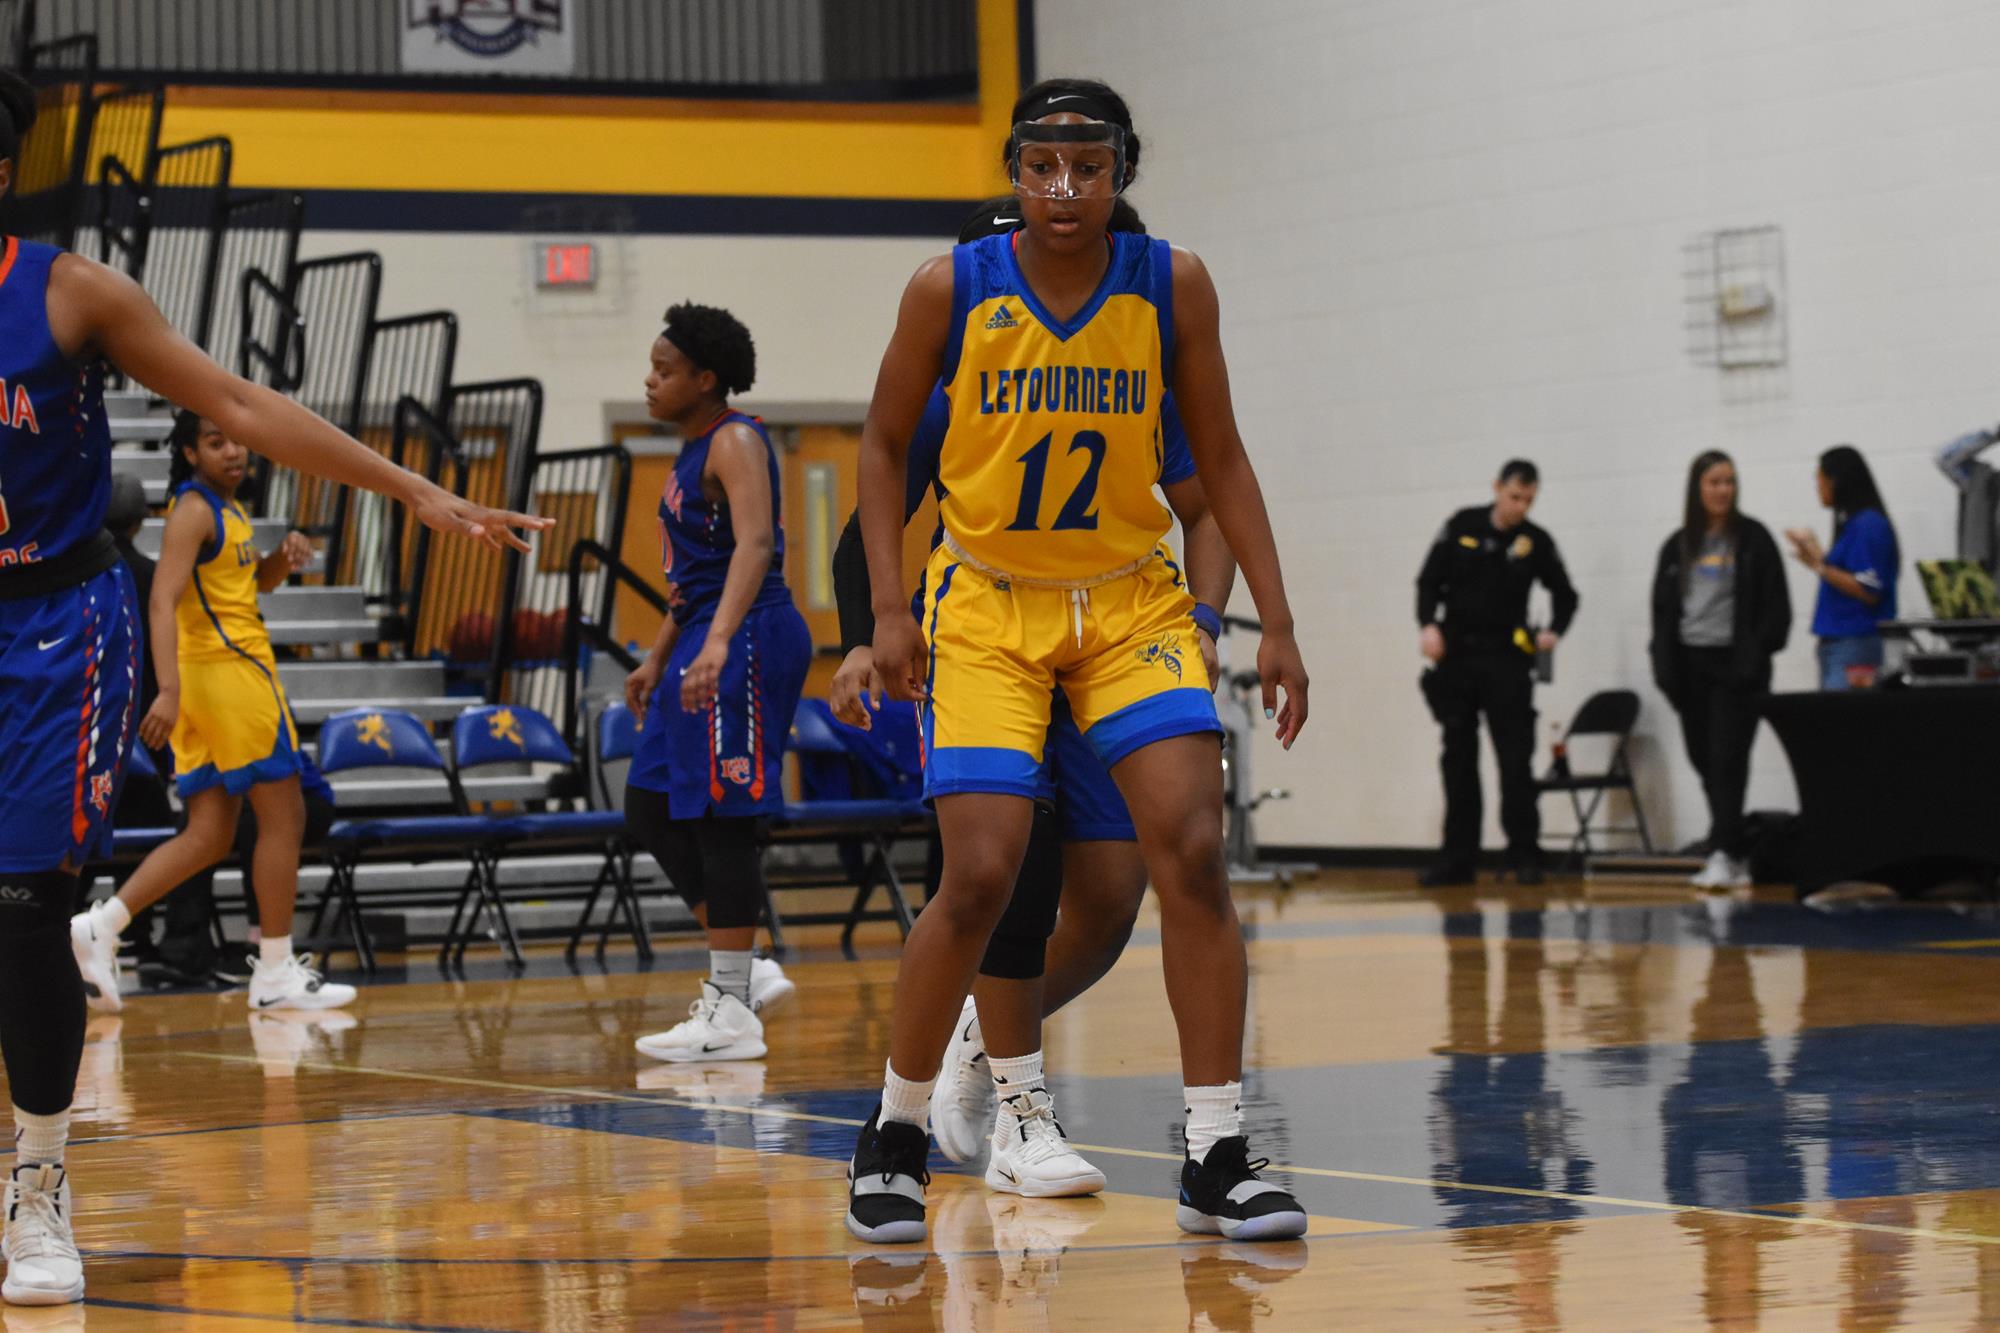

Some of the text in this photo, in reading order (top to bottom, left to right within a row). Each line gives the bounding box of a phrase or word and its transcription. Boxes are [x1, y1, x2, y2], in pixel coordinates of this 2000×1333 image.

[985, 319, 1019, 330] adidas
[979, 366, 1147, 415] LETOURNEAU
[1004, 430, 1107, 531] 12
